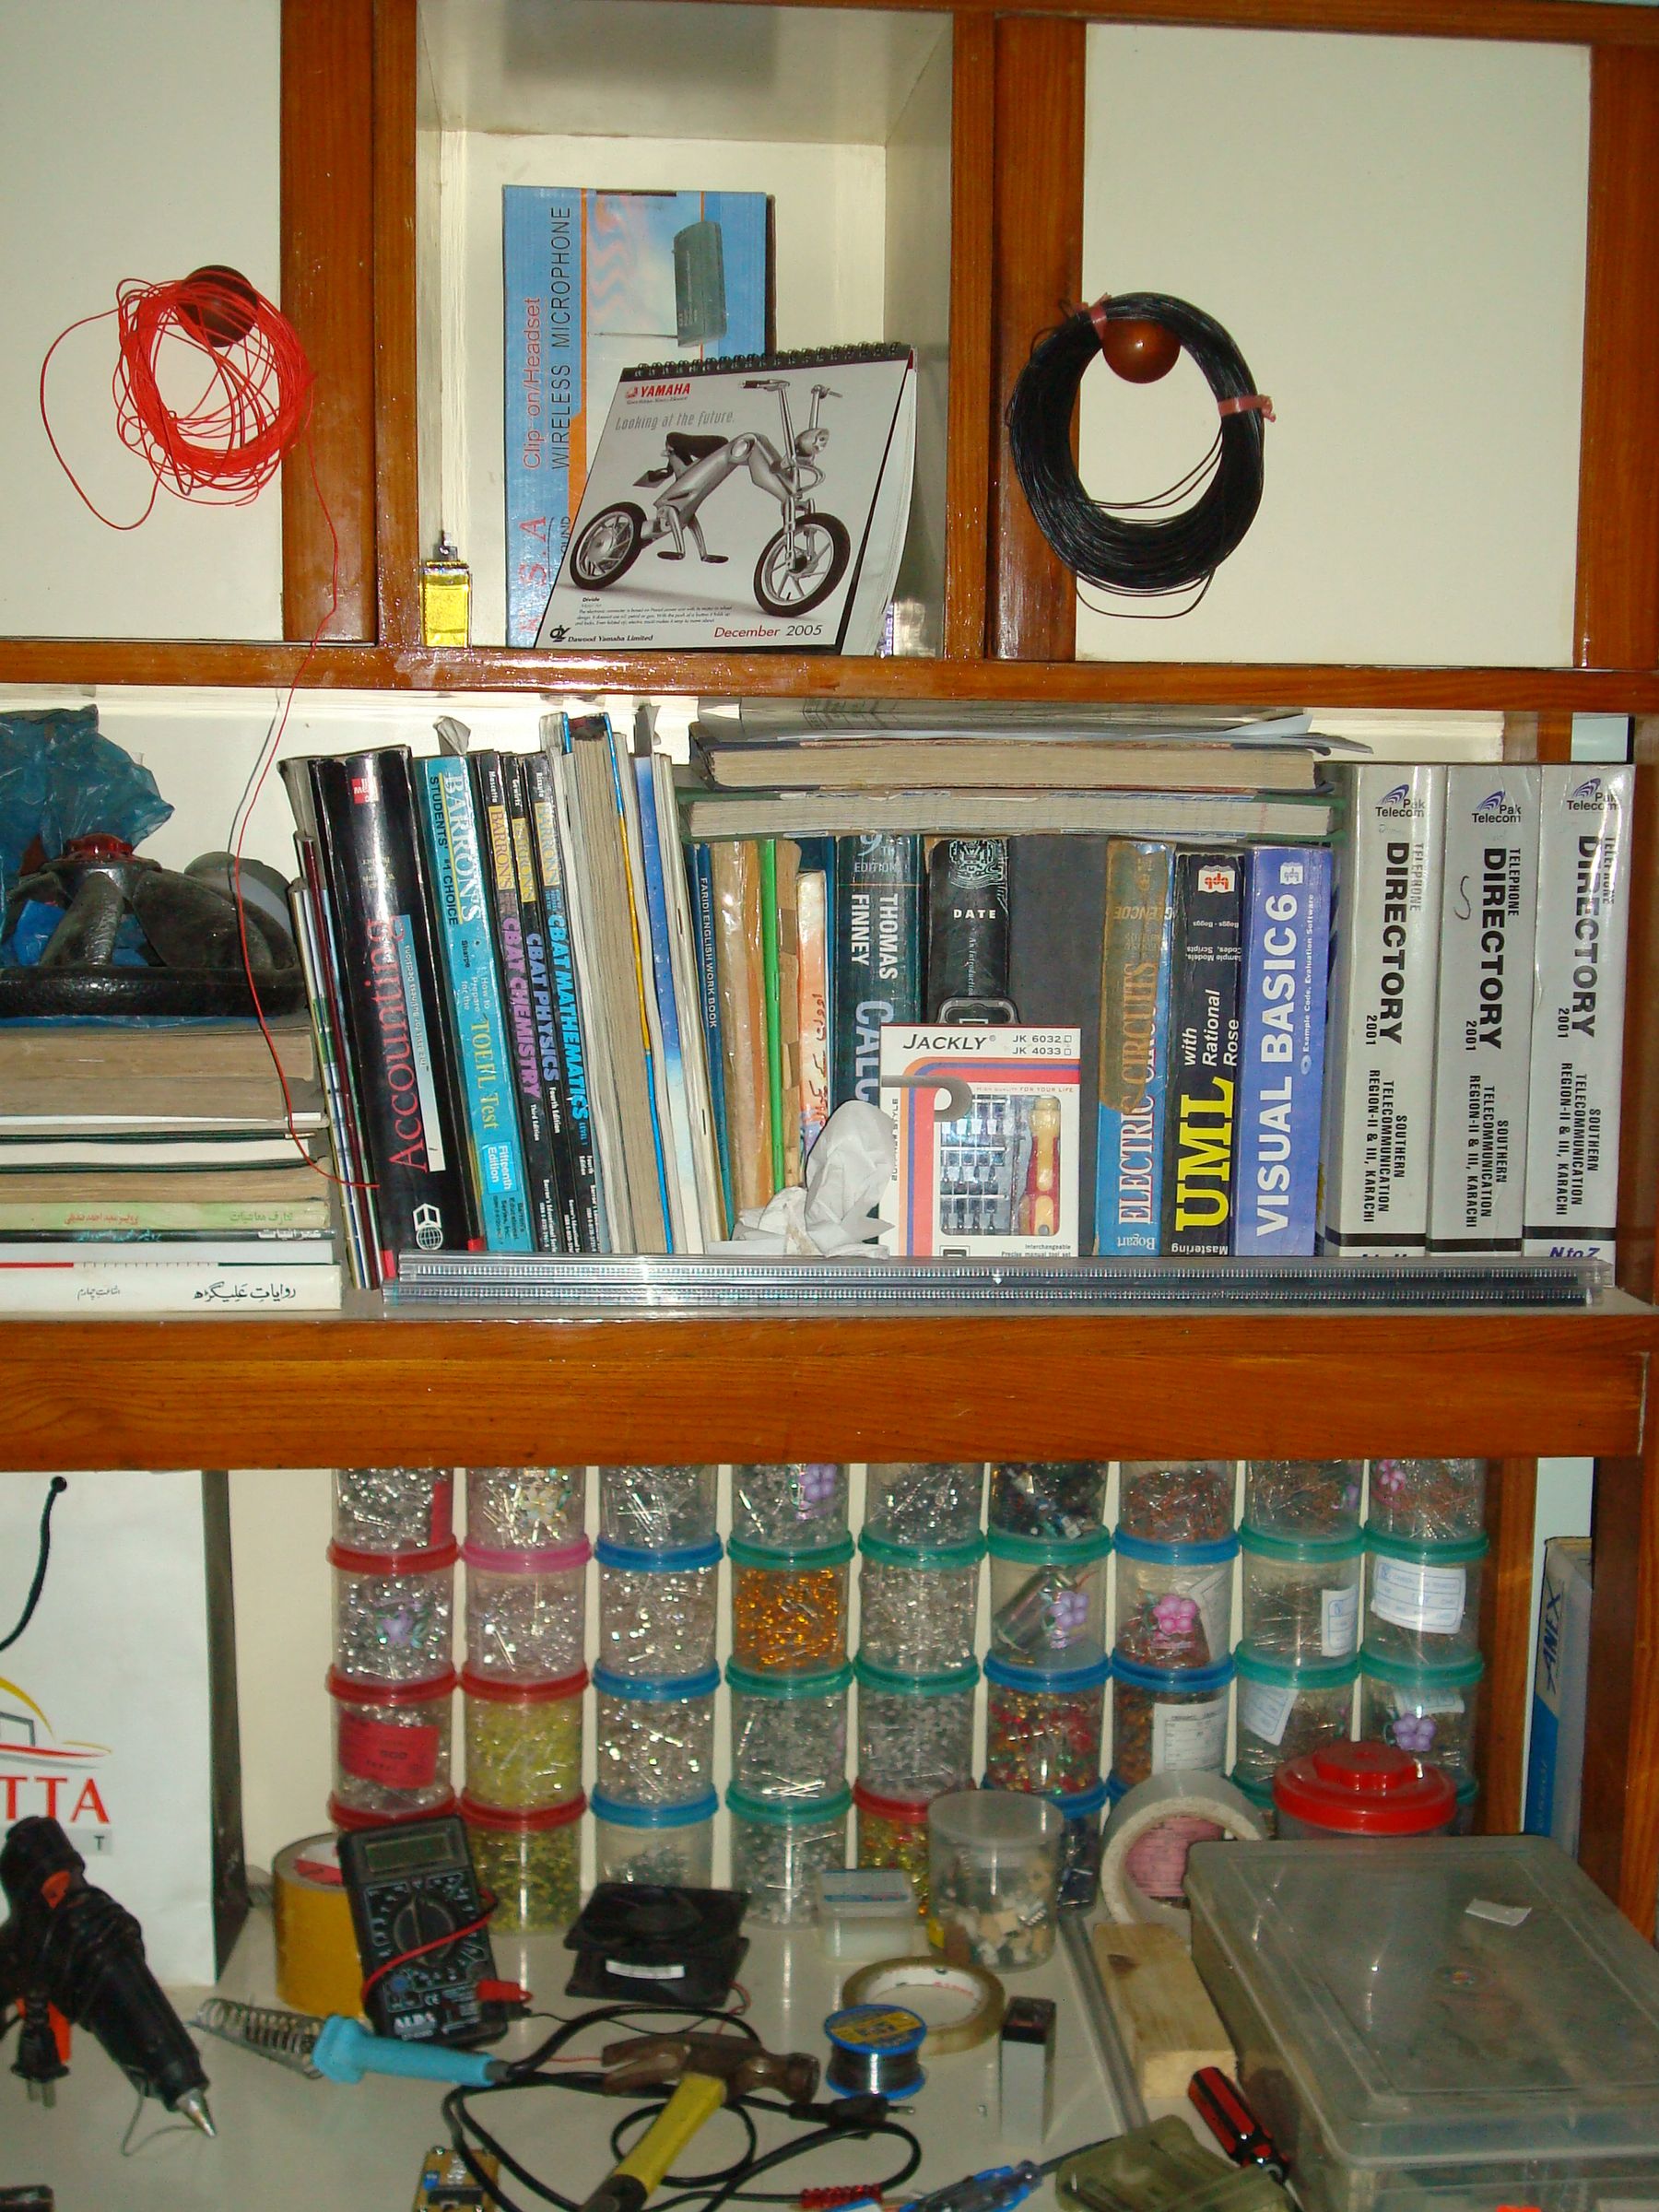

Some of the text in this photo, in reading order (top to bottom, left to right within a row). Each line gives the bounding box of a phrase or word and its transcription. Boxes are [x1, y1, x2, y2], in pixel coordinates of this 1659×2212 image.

[551, 206, 571, 469] WIRELESS MICROPHONE
[523, 297, 546, 471] Clip-on/Headset
[641, 383, 692, 397] YAMAHA
[615, 416, 658, 431] Looking
[662, 413, 674, 427] at
[677, 412, 695, 426] the
[559, 516, 571, 559] OUND
[714, 625, 823, 638] December 2005
[488, 771, 499, 803] Mascetta
[1375, 806, 1425, 818] Telecom
[1403, 798, 1425, 809] Pak
[1499, 804, 1521, 814] Pak
[1472, 812, 1521, 823] Telecom
[429, 775, 448, 849] STUDENTS'
[442, 873, 459, 925] CHOICE
[491, 811, 512, 888] BARRON'S
[1205, 873, 1229, 889] bpb
[1409, 842, 1424, 912] TELEPHONE
[1508, 848, 1521, 916] TELEPHONE
[851, 894, 870, 966] FINNEY
[953, 910, 996, 919] DATE
[1194, 921, 1239, 929] Boggs Boggs
[1265, 894, 1298, 921] 6
[1306, 895, 1314, 935] Software
[461, 939, 471, 968] Sharpe
[502, 918, 527, 973] CBAT
[547, 914, 570, 968] CBAT
[700, 877, 717, 1028] FARIDI ENGLISH WORK BOOK
[878, 894, 899, 980] THOMAS
[1186, 945, 1213, 954] Scripts
[1380, 842, 1410, 1044] DIRECTORY
[1479, 848, 1507, 1050] DIRECTORY
[1571, 835, 1601, 1038] DIRECTORY
[1305, 941, 1313, 984] Evaluation
[480, 977, 490, 1010] How to
[526, 933, 559, 1081] CBAT PHYSICS
[1261, 927, 1298, 1062] BASIC
[365, 914, 429, 1172] Accounting
[509, 977, 541, 1099] CHEMISTRY
[555, 971, 590, 1120] MATHEMATICS
[902, 1033, 988, 1051] JACKLY
[1032, 1035, 1061, 1043] 6032
[1121, 961, 1159, 1083] CIRCUITS
[1182, 1028, 1197, 1065] with
[1202, 990, 1220, 1066] Rational
[1223, 1019, 1239, 1066] Rose
[1303, 1018, 1312, 1052] Example
[1366, 1015, 1377, 1045] 2001
[1465, 1020, 1477, 1051] 2001
[1558, 1008, 1569, 1039] 2001
[470, 1018, 500, 1129] TOEFL Test
[1031, 1047, 1061, 1055] 4033
[530, 1103, 538, 1121] Third
[548, 1087, 560, 1134] Fourth Edition
[1368, 1070, 1380, 1128] REGION-II
[1467, 1075, 1480, 1133] REGION-II
[1559, 1063, 1572, 1120] REGION-II
[1175, 1076, 1234, 1231] UML
[1367, 1133, 1379, 1142] &
[1378, 1080, 1394, 1212] TELECOMMUNICATION
[1394, 1115, 1407, 1178] SOUTHERN
[1467, 1138, 1479, 1147] &
[1481, 1086, 1495, 1218] TELECOMMUNICATION
[1496, 1120, 1509, 1183] SOUTHERN
[1559, 1125, 1571, 1135] &
[1571, 1074, 1586, 1206] TELECOMMUNICATION
[1587, 1109, 1601, 1171] SOUTHERN
[488, 1147, 499, 1182] Edition
[498, 1145, 512, 1190] Fifteenth
[1119, 1096, 1154, 1224] ELECTRIC
[1256, 1077, 1292, 1237] VISUAL
[1364, 1171, 1376, 1222] KARACHI
[1466, 1176, 1477, 1228] KARACHI
[1556, 1163, 1569, 1215] KARACHI
[1117, 1234, 1156, 1251] Bogart
[1171, 1242, 1229, 1255] Mastering
